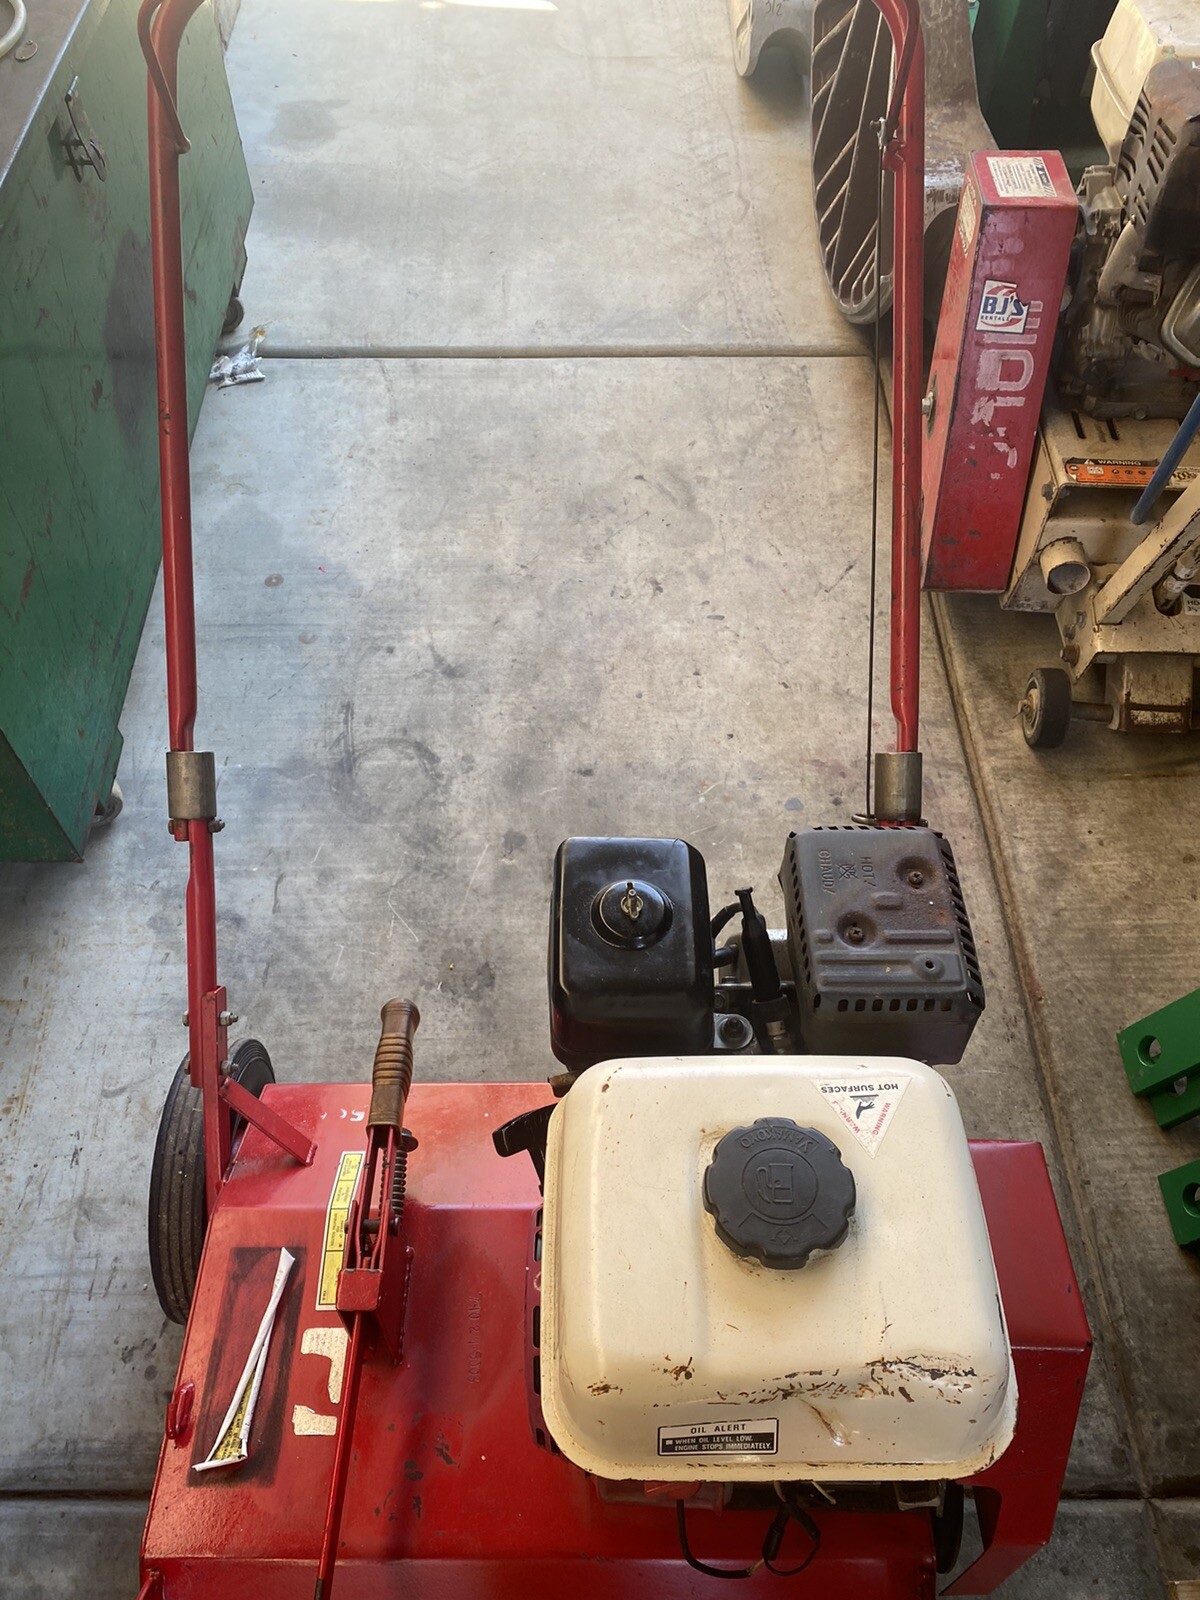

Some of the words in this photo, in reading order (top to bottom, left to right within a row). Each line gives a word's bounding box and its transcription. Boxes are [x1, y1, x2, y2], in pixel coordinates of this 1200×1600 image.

[981, 295, 1024, 317] BJ'S
[818, 849, 836, 896] CHAUD!
[860, 856, 876, 888] HOT!
[820, 1084, 875, 1093] SURFACES
[878, 1083, 899, 1091] HOT
[872, 1102, 891, 1136] WARNING
[714, 1424, 747, 1432] ALERT
